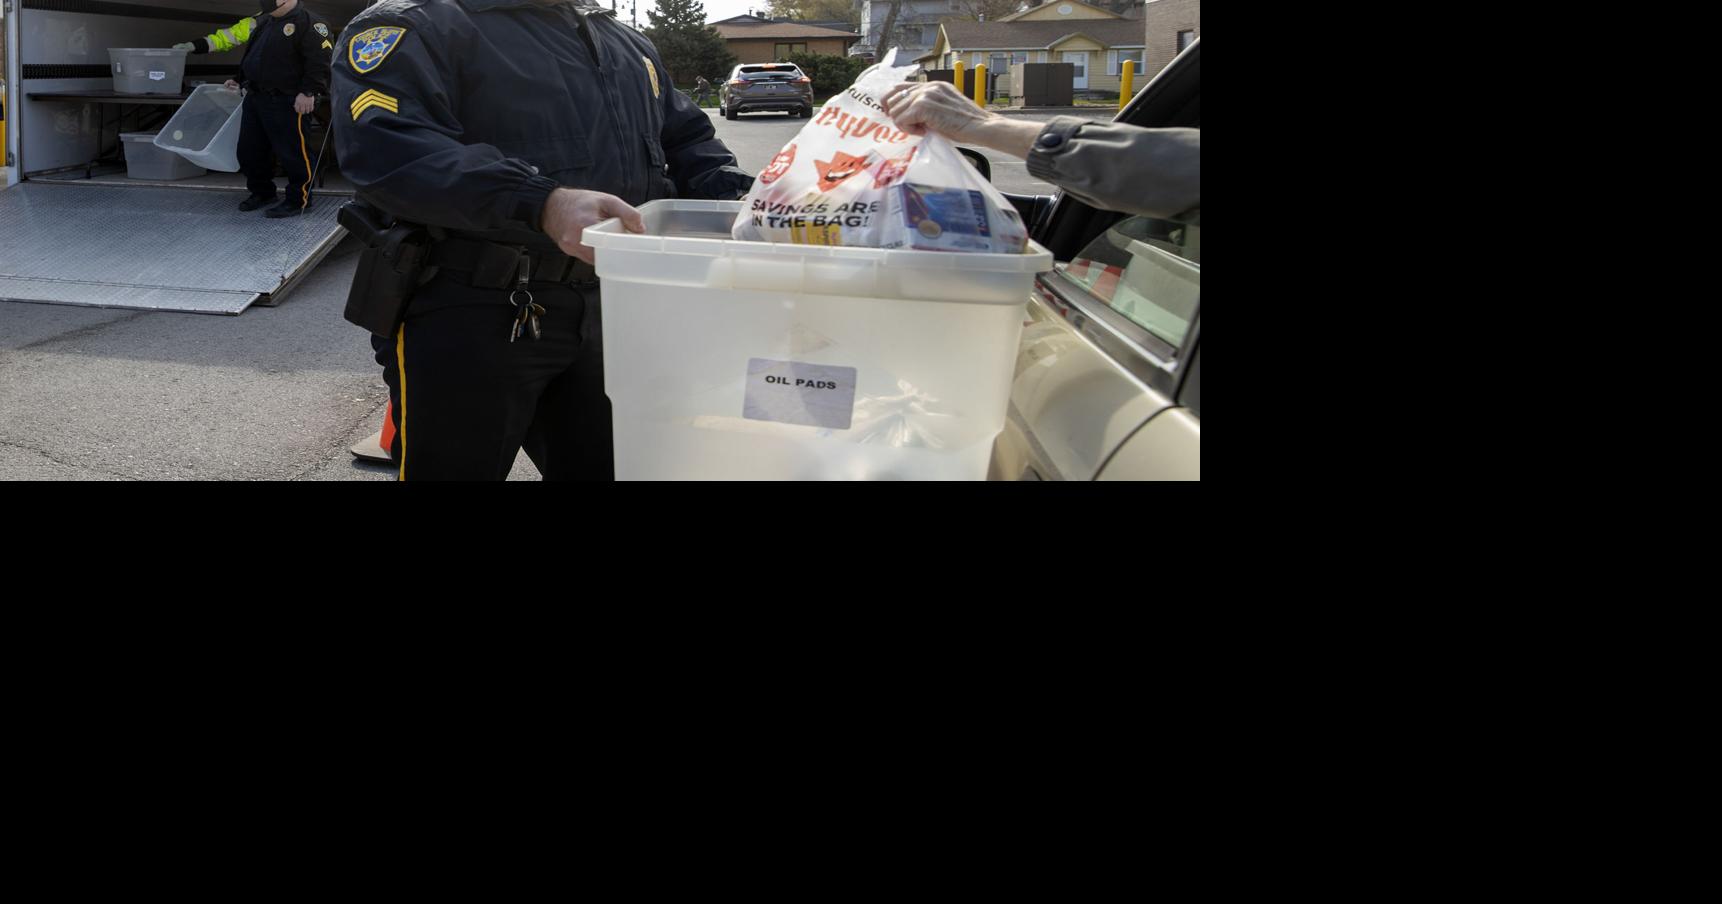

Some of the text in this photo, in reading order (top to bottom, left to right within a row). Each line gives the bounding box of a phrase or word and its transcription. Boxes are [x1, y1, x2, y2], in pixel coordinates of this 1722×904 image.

[751, 199, 881, 215] SAVINGS ARE
[751, 213, 869, 228] IN THE BAG!
[764, 375, 837, 390] OIL PADS
